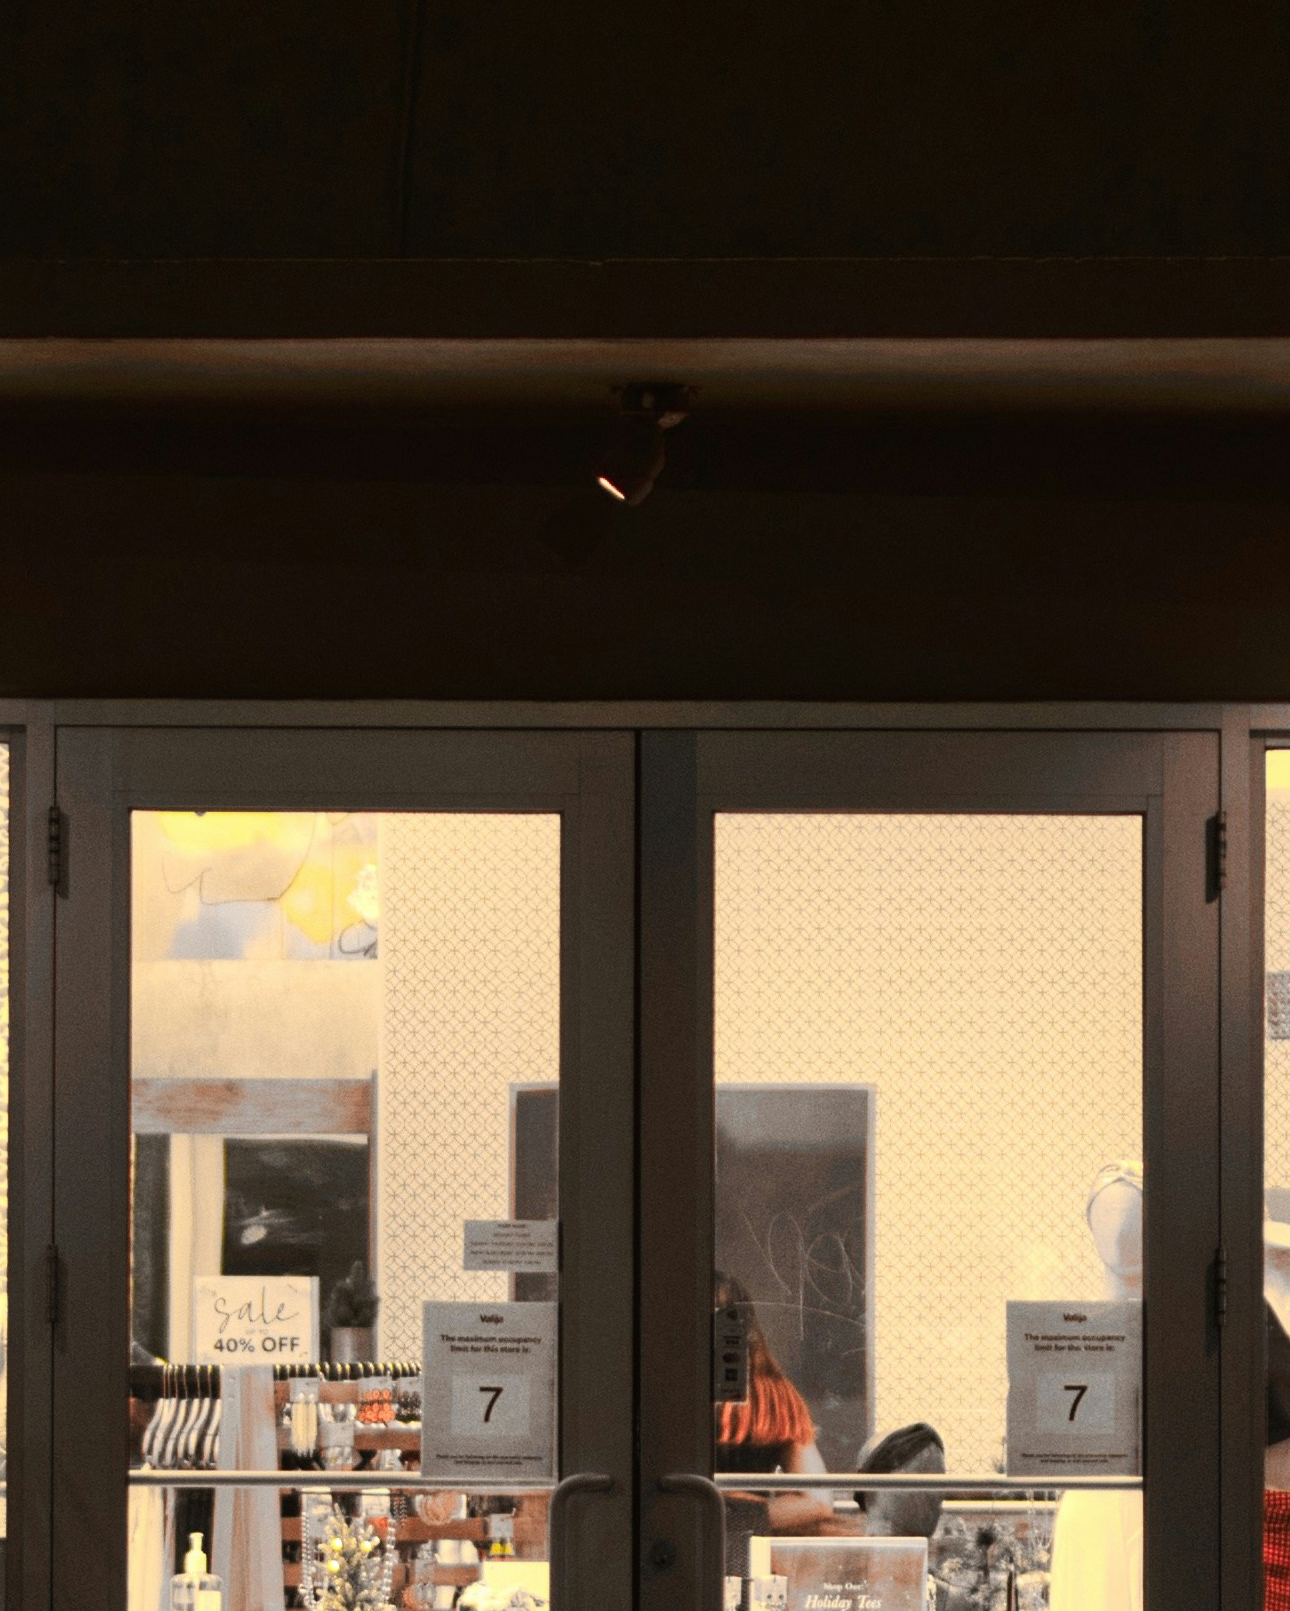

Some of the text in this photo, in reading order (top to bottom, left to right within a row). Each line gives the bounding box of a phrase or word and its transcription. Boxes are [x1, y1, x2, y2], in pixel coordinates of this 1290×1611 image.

[214, 1336, 300, 1353] 40% OFF
[479, 1386, 504, 1422] 7
[1064, 1385, 1088, 1422] 7
[857, 1594, 882, 1609] Tees
